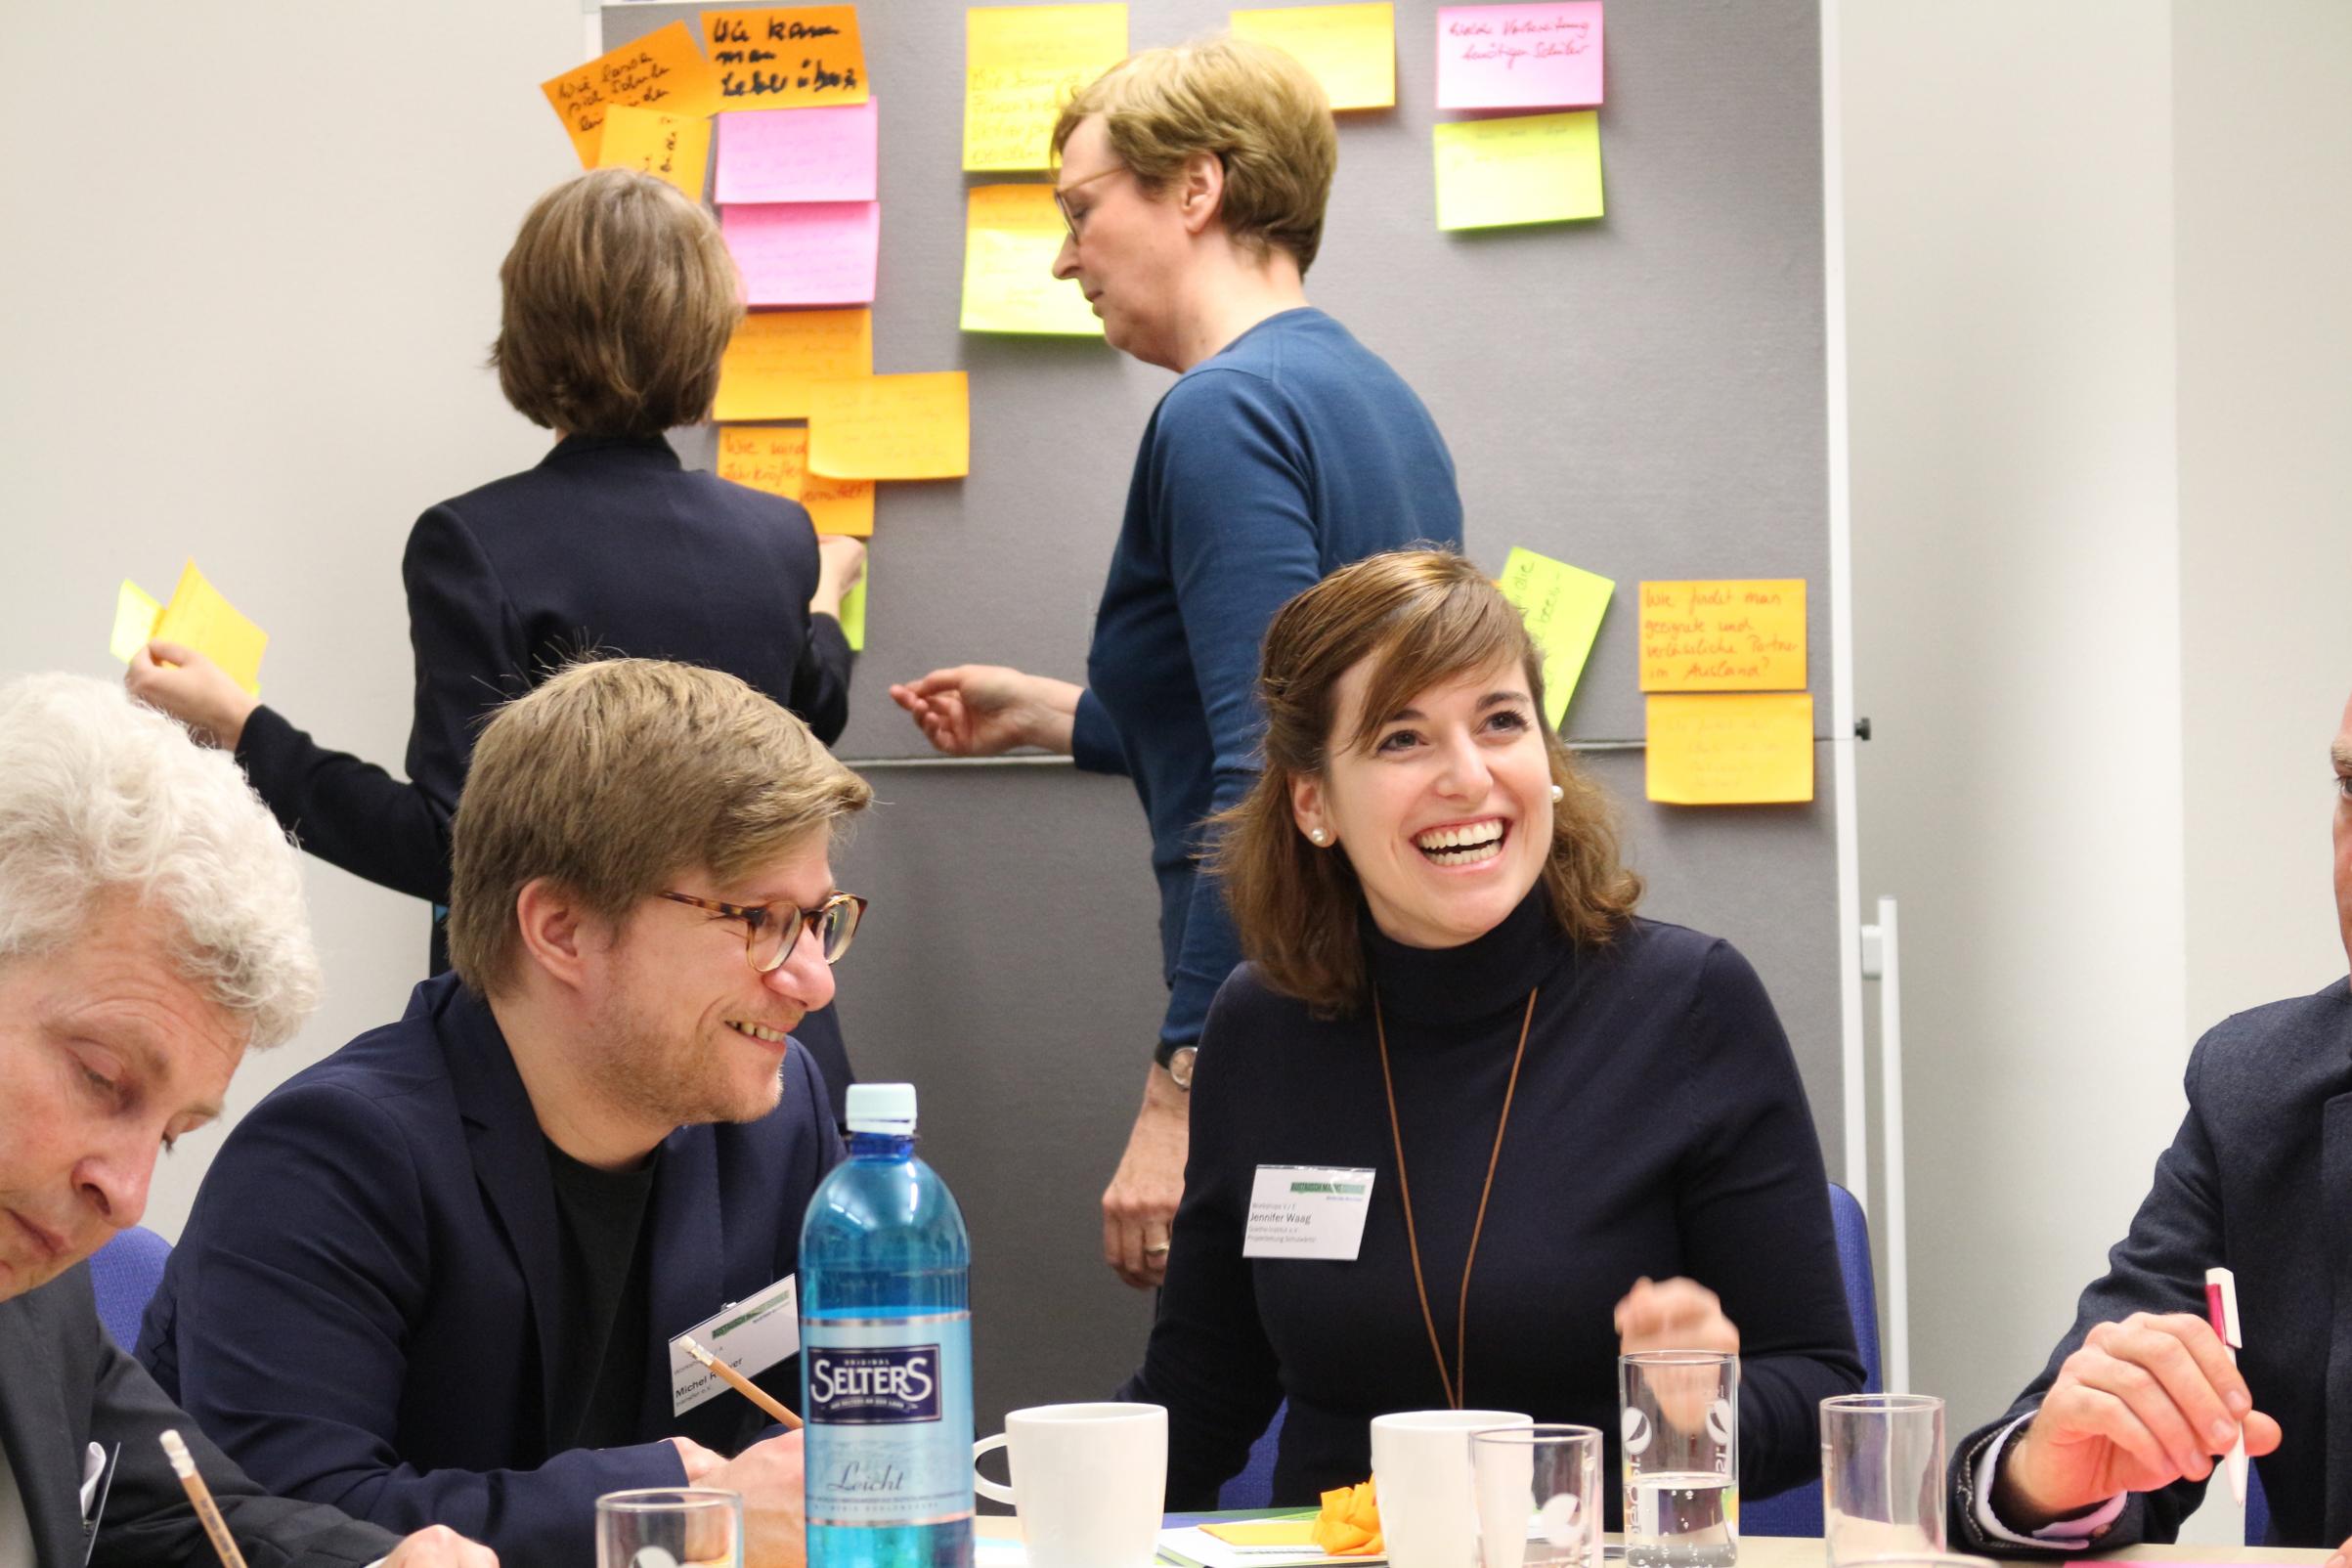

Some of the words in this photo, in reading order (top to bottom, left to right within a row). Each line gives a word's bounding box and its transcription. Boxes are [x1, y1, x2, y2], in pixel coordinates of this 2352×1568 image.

[1744, 591, 1782, 605] man
[1249, 1212, 1284, 1223] Jennifer
[1286, 1213, 1312, 1226] Waag
[675, 1375, 708, 1399] Michel
[810, 1356, 933, 1404] SELTERS
[826, 1459, 904, 1492] Leicht
